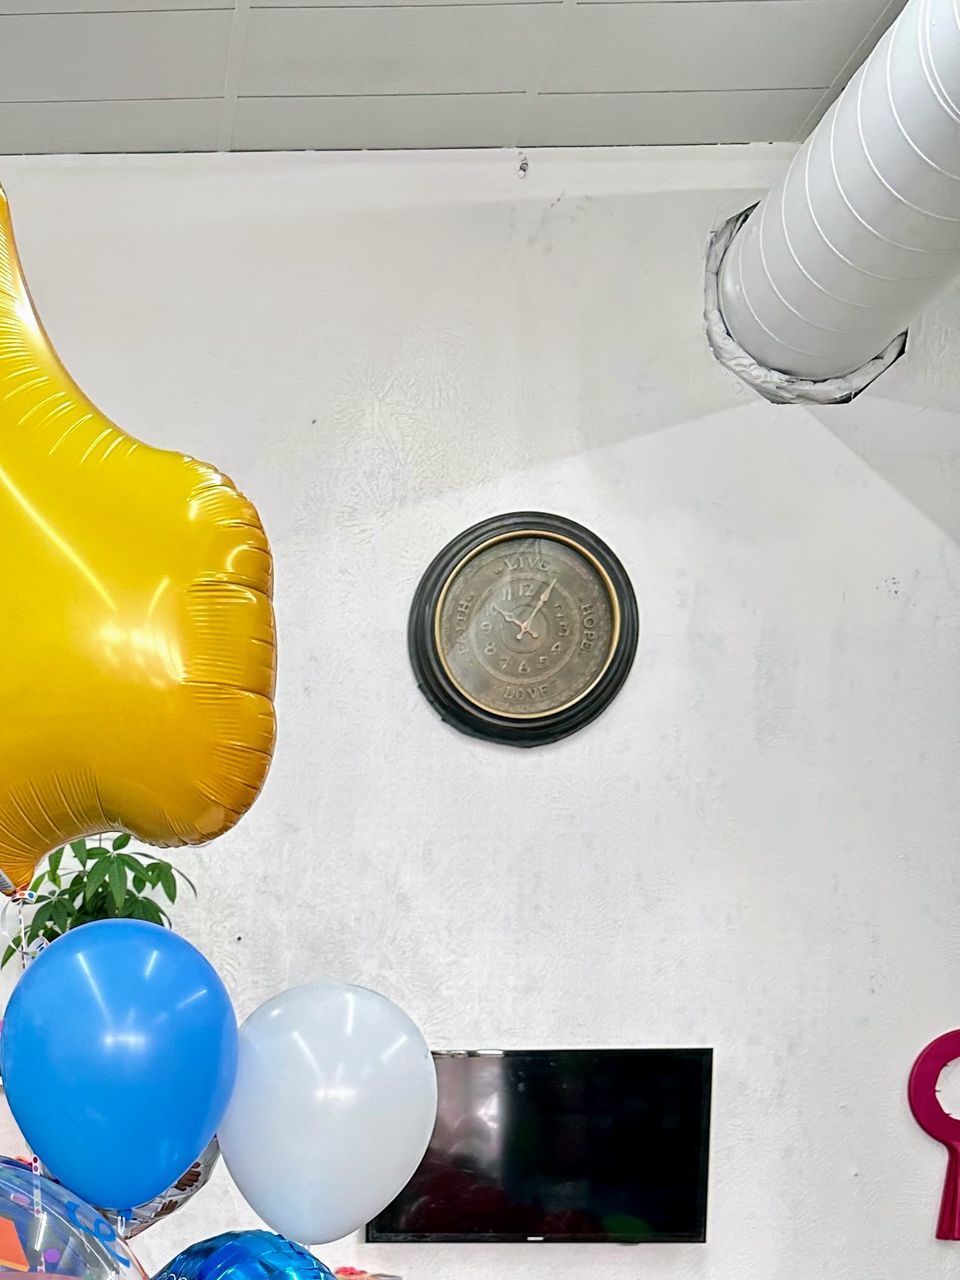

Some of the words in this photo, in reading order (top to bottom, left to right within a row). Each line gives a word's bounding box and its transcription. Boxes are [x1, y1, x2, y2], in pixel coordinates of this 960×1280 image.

[503, 556, 550, 571] LIVE
[519, 583, 534, 597] 12
[580, 602, 597, 651] HOPE
[503, 685, 549, 700] LOVE
